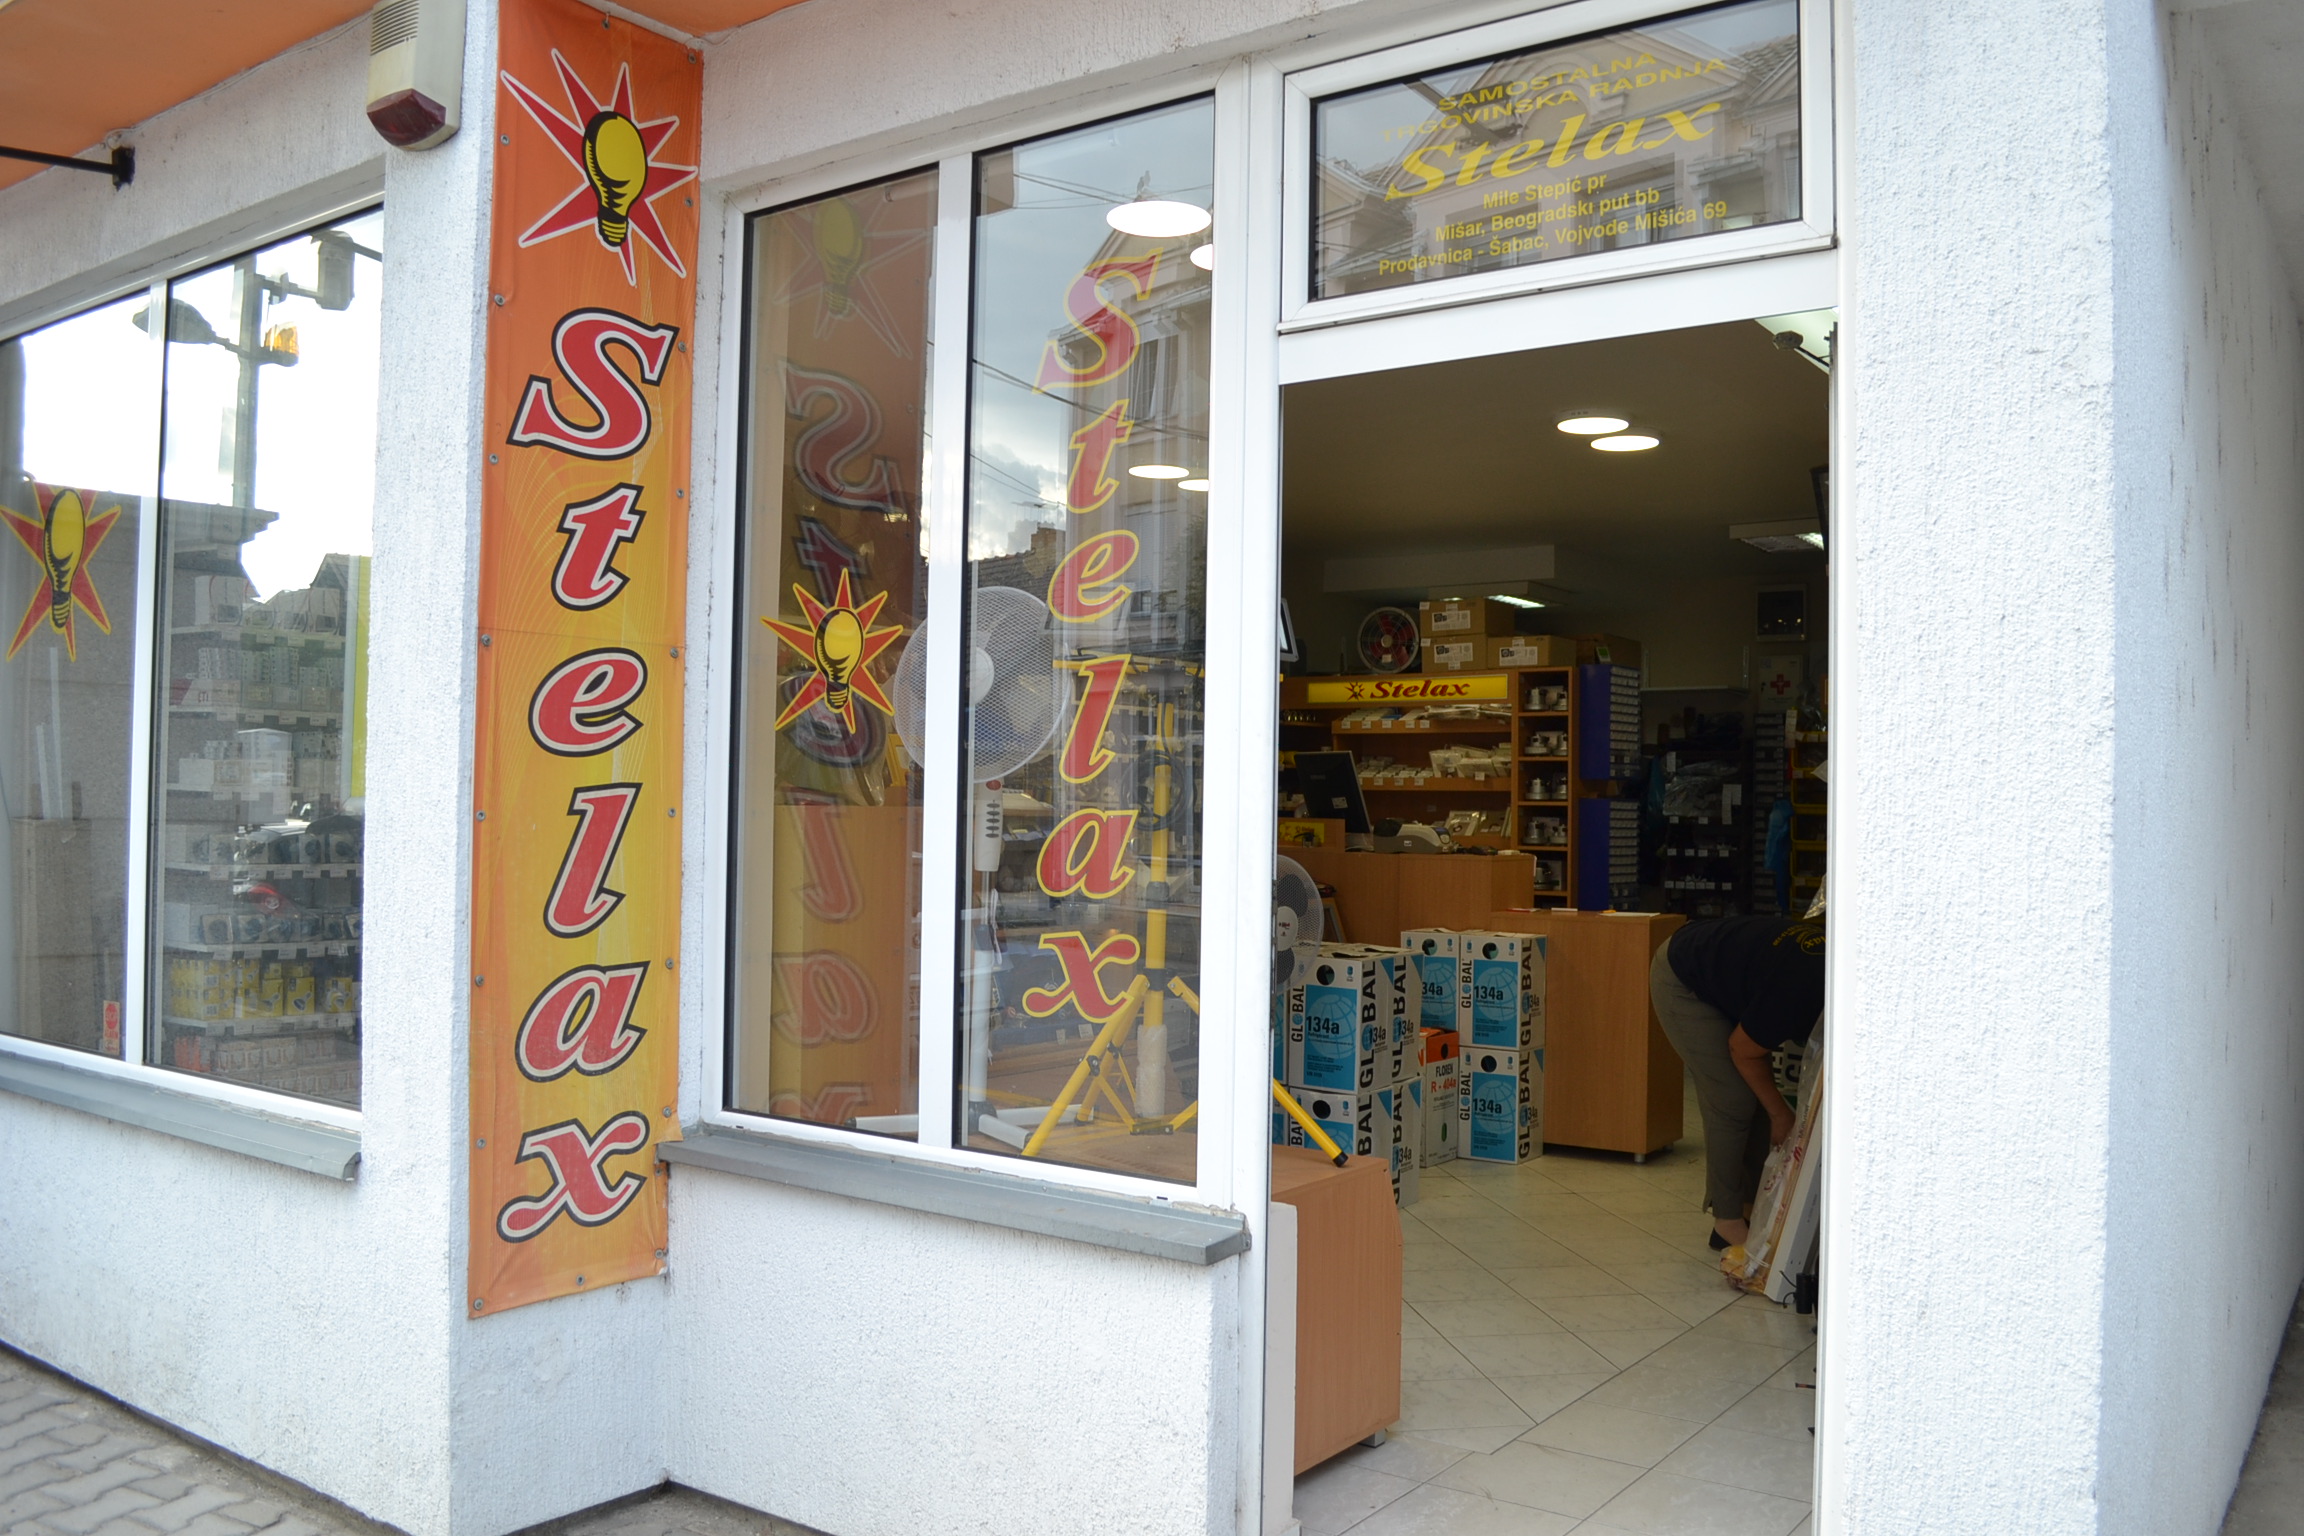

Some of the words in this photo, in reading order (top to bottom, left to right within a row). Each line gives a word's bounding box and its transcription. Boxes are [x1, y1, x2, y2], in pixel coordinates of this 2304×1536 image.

[1378, 90, 1579, 142] TRGOVINSKA
[1589, 58, 1727, 98] RADNJA
[1438, 53, 1657, 111] SAMOSTALNA
[1384, 102, 1721, 201] Stelax
[1435, 221, 1486, 242] Mišar,
[1491, 200, 1594, 232] Beogradski
[1600, 192, 1630, 216] put
[1635, 187, 1660, 206] bb
[1483, 190, 1520, 209] Mile
[1525, 175, 1582, 200] Stepić
[1588, 174, 1607, 194] pr
[1379, 247, 1473, 275] Prodavnica
[1489, 234, 1549, 256] Šabac,
[1555, 219, 1629, 245] Vojvode
[1635, 206, 1697, 231] Mišića
[1703, 201, 1727, 219] 69
[1022, 247, 1163, 1024] Stelax
[1370, 680, 1470, 698] Stelax
[496, 306, 680, 1244] Stelax
[1421, 981, 1443, 996] 34a
[1461, 959, 1472, 1008] GLOBAL
[1474, 986, 1504, 1000] 134a
[1521, 940, 1532, 1045] GLOBAL
[1291, 985, 1304, 1042] GLOBAL
[1306, 1016, 1340, 1034] 134a
[1360, 961, 1376, 1088] GLOBAL
[1460, 1072, 1471, 1120] GLOBAL
[1473, 1098, 1502, 1114] 134a
[1519, 1052, 1530, 1158] GLOBAL
